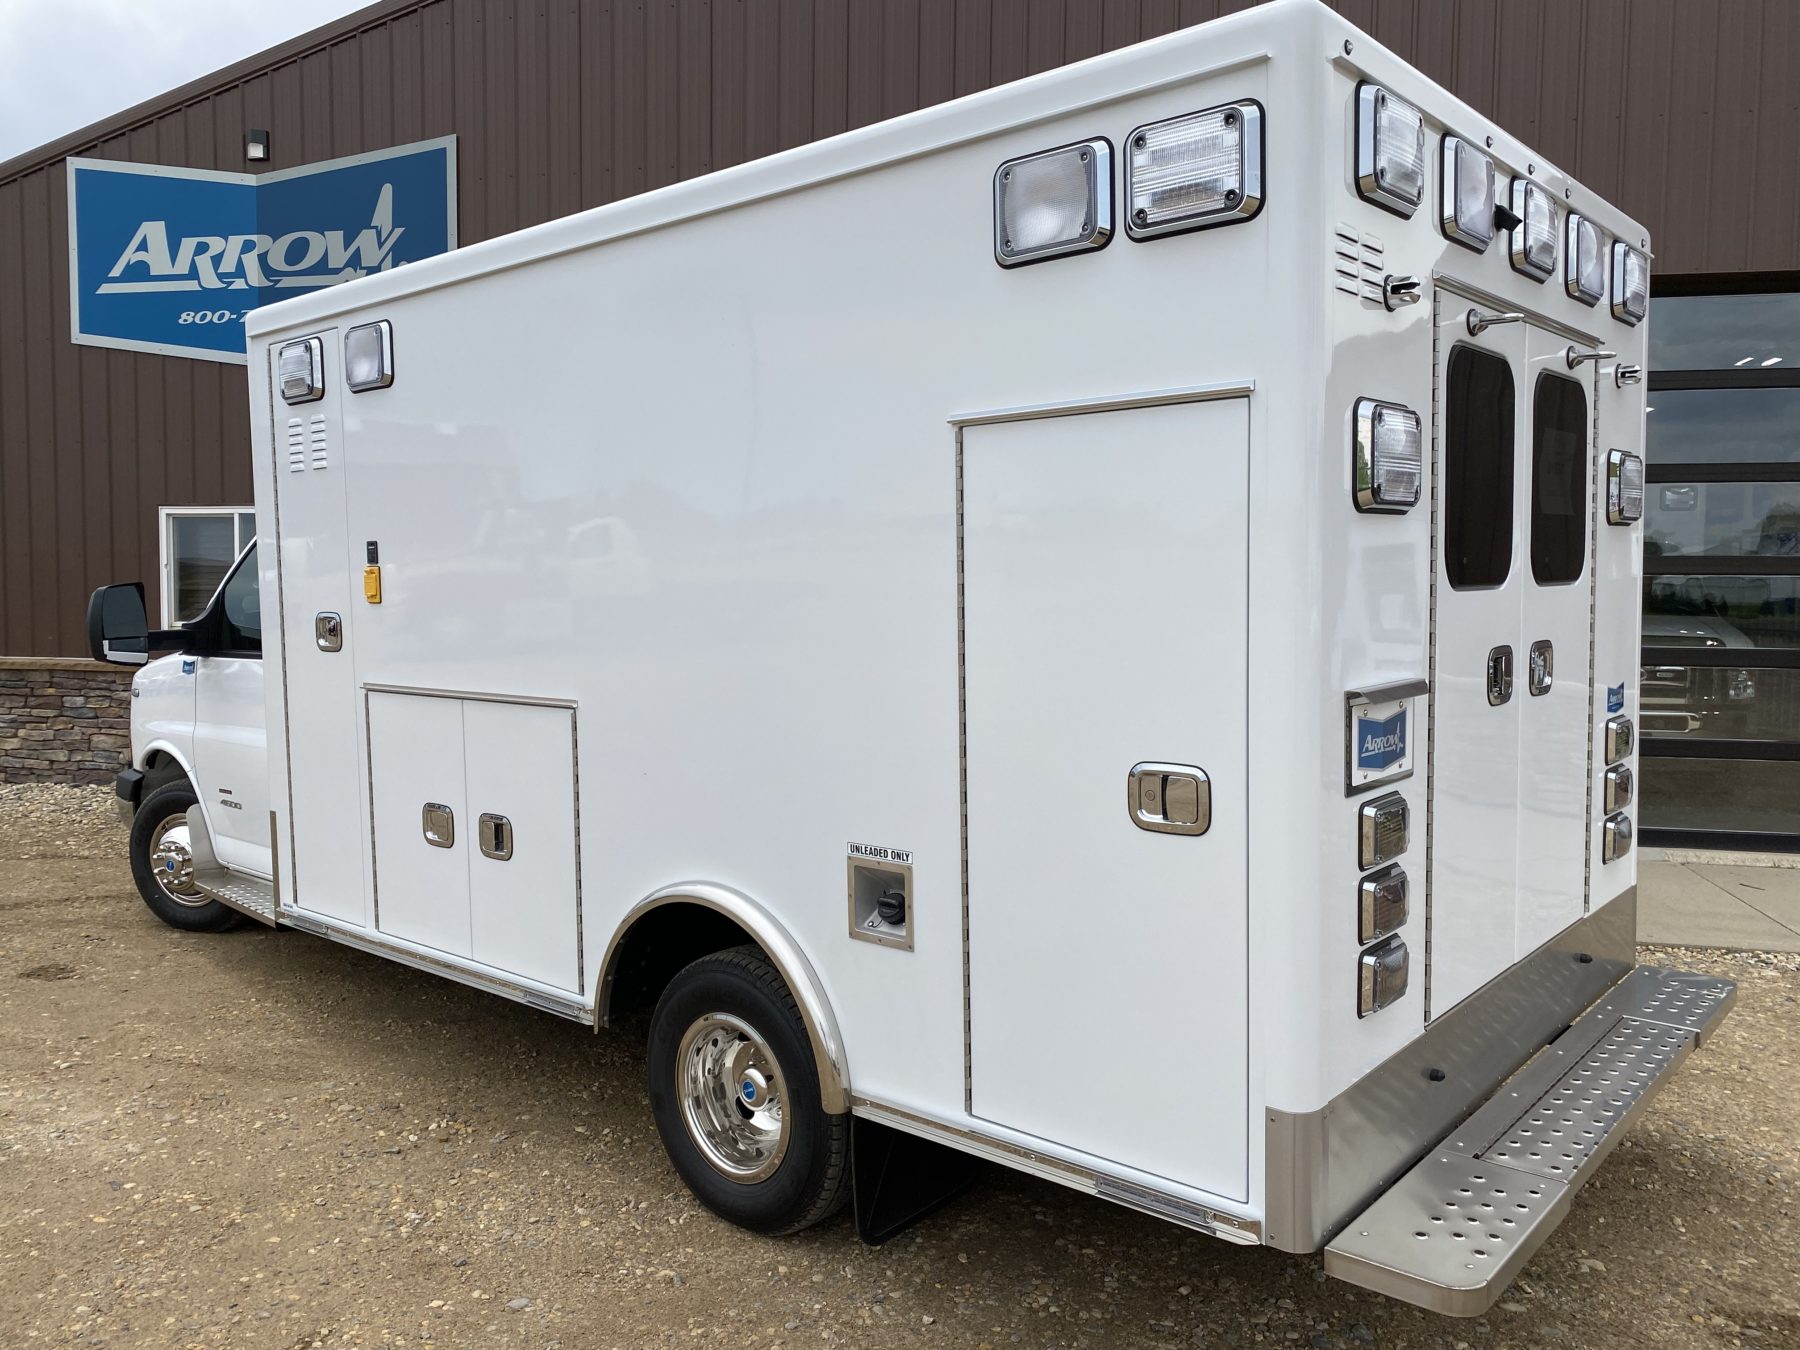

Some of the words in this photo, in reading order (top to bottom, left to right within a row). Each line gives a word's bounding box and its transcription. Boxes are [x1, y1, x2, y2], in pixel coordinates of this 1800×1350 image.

[108, 220, 405, 289] ARROW
[1362, 734, 1400, 753] ARROW
[850, 844, 889, 859] UNLEADED
[890, 850, 910, 862] ONLY
